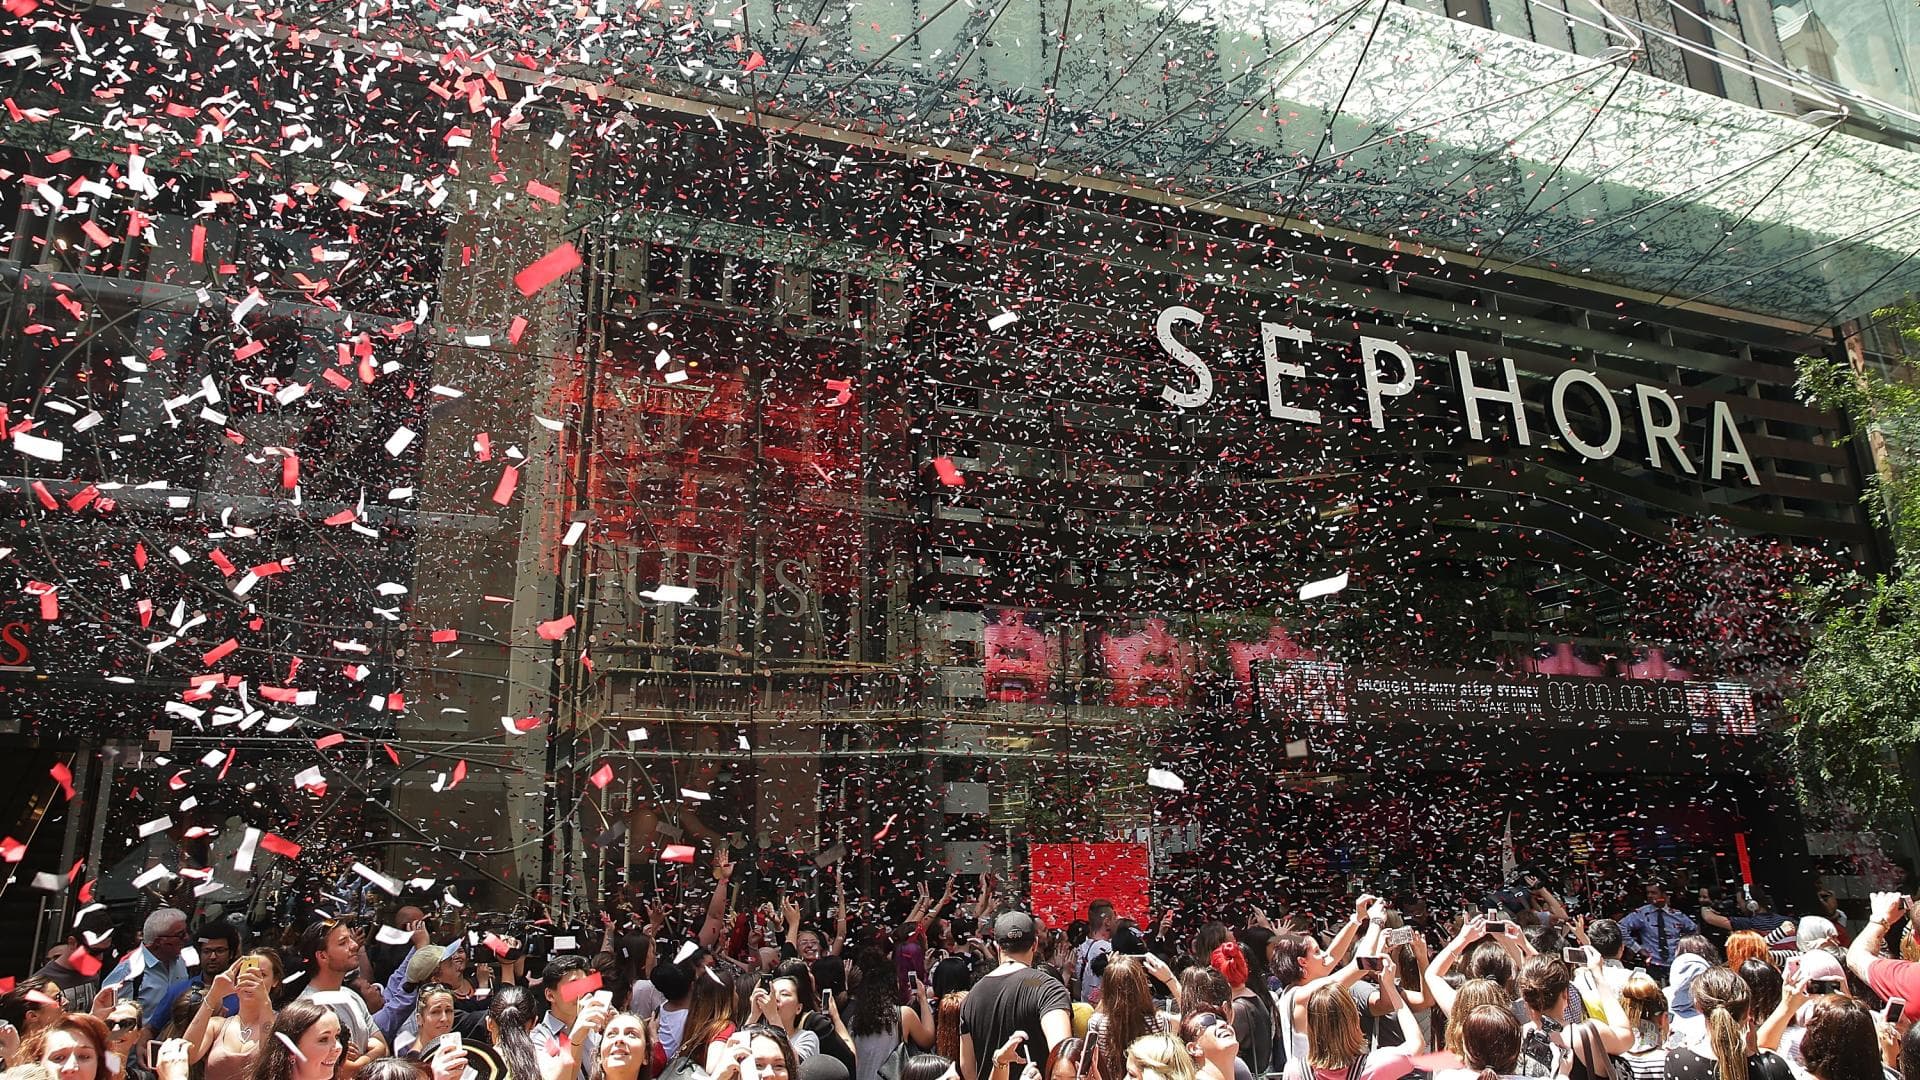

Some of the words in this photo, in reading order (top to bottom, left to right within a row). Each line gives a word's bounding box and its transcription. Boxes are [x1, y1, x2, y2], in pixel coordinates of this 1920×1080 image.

[1156, 305, 1761, 486] SEPHORA
[1356, 679, 1409, 692] ENOUGH
[1413, 682, 1456, 695] BEAUTY
[1459, 684, 1493, 696] SLEEP
[1497, 685, 1540, 698] SYDNEY
[1430, 698, 1457, 712] TIME
[1462, 700, 1476, 712] TO
[1479, 701, 1511, 714] WAKE
[1530, 703, 1542, 715] IN
